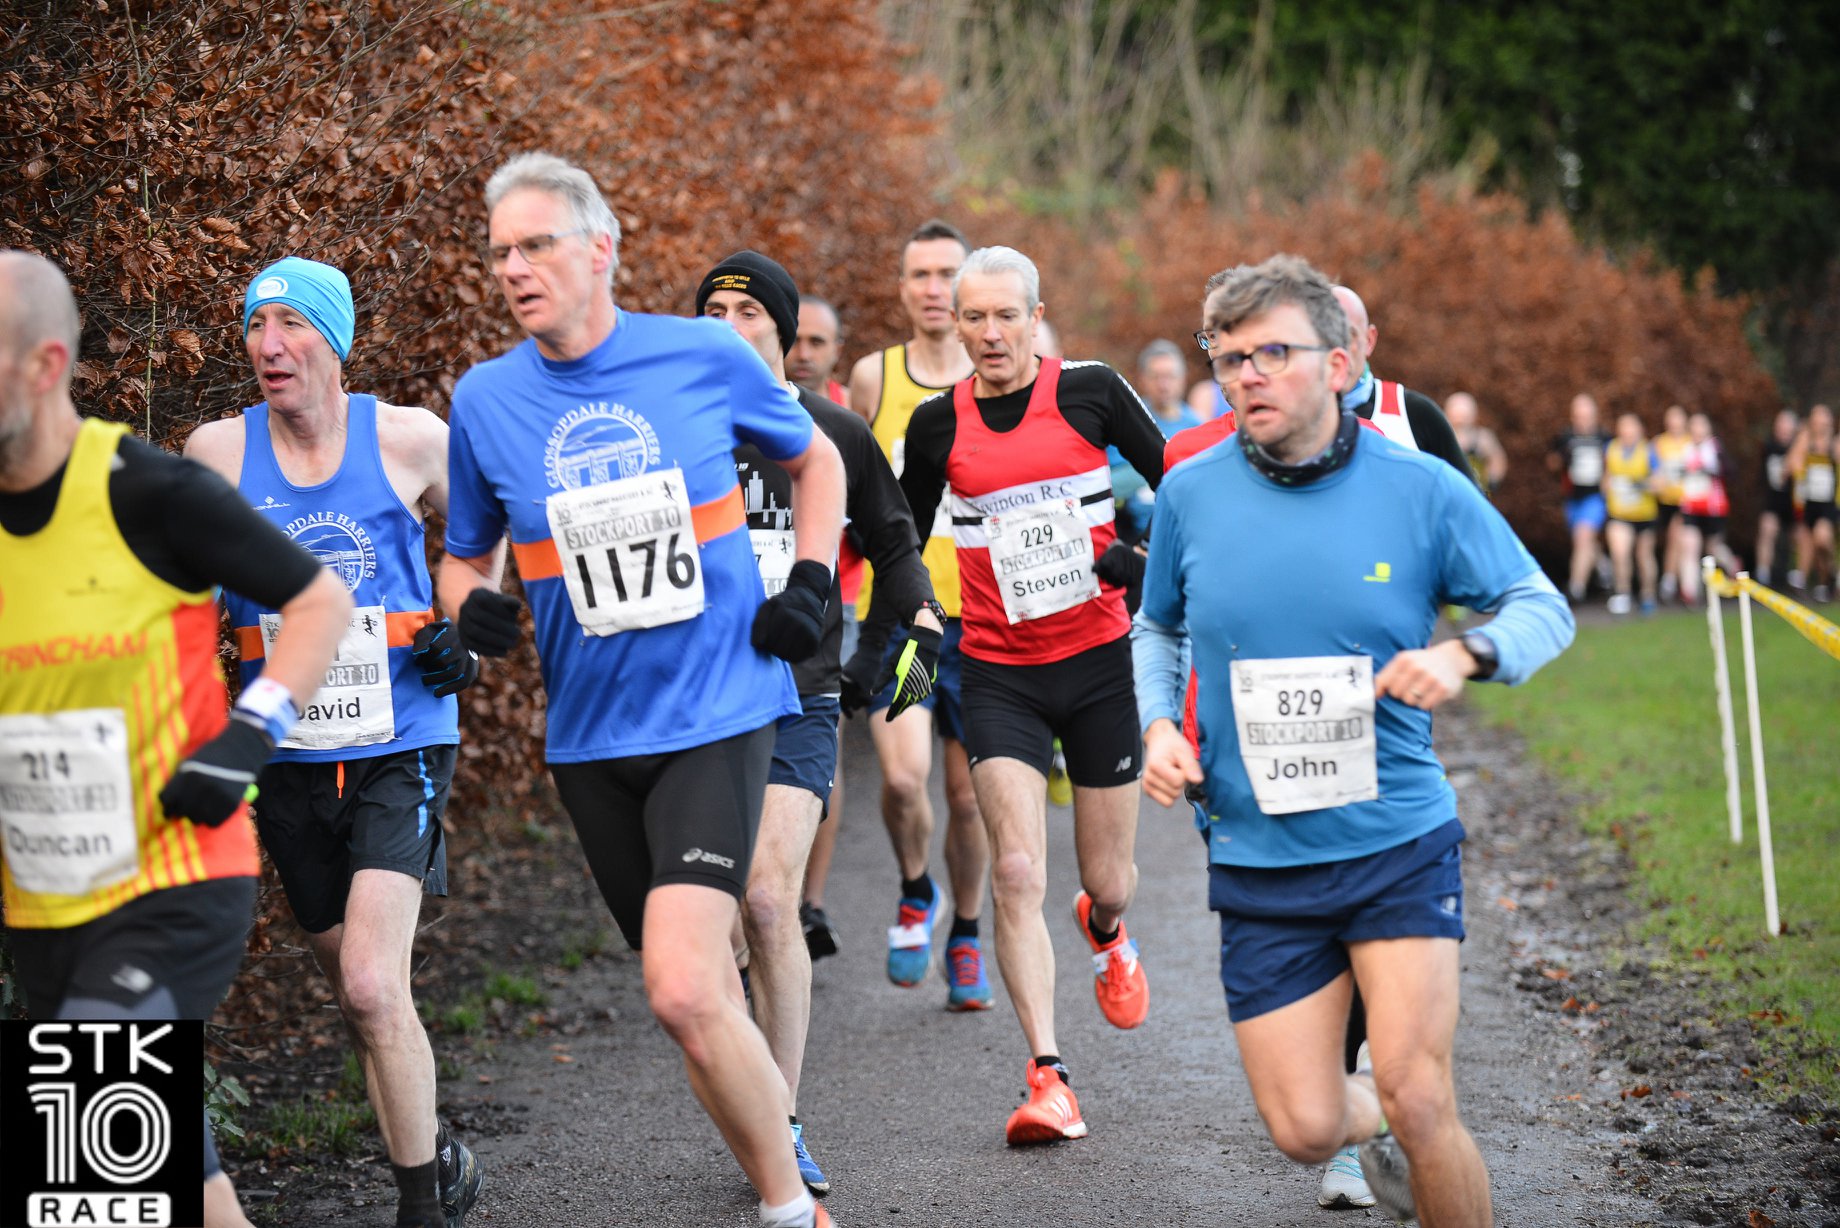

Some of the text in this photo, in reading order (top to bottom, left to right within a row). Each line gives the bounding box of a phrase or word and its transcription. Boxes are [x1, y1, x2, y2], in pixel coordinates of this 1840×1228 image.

[611, 402, 661, 466] HARRIERS
[566, 506, 682, 550] STOCKPORT 10
[1021, 524, 1053, 548] 229
[336, 513, 376, 579] HARRIERS
[575, 532, 696, 609] 1176
[1013, 569, 1082, 597] Steven
[0, 628, 148, 673] RINCHAM
[360, 664, 377, 685] 10
[298, 697, 361, 720] avid
[1278, 690, 1323, 716] 829
[1249, 718, 1363, 745] STOCKPORT 10
[21, 751, 70, 781] 214
[1267, 757, 1338, 780] John
[8, 825, 112, 857] Duncan
